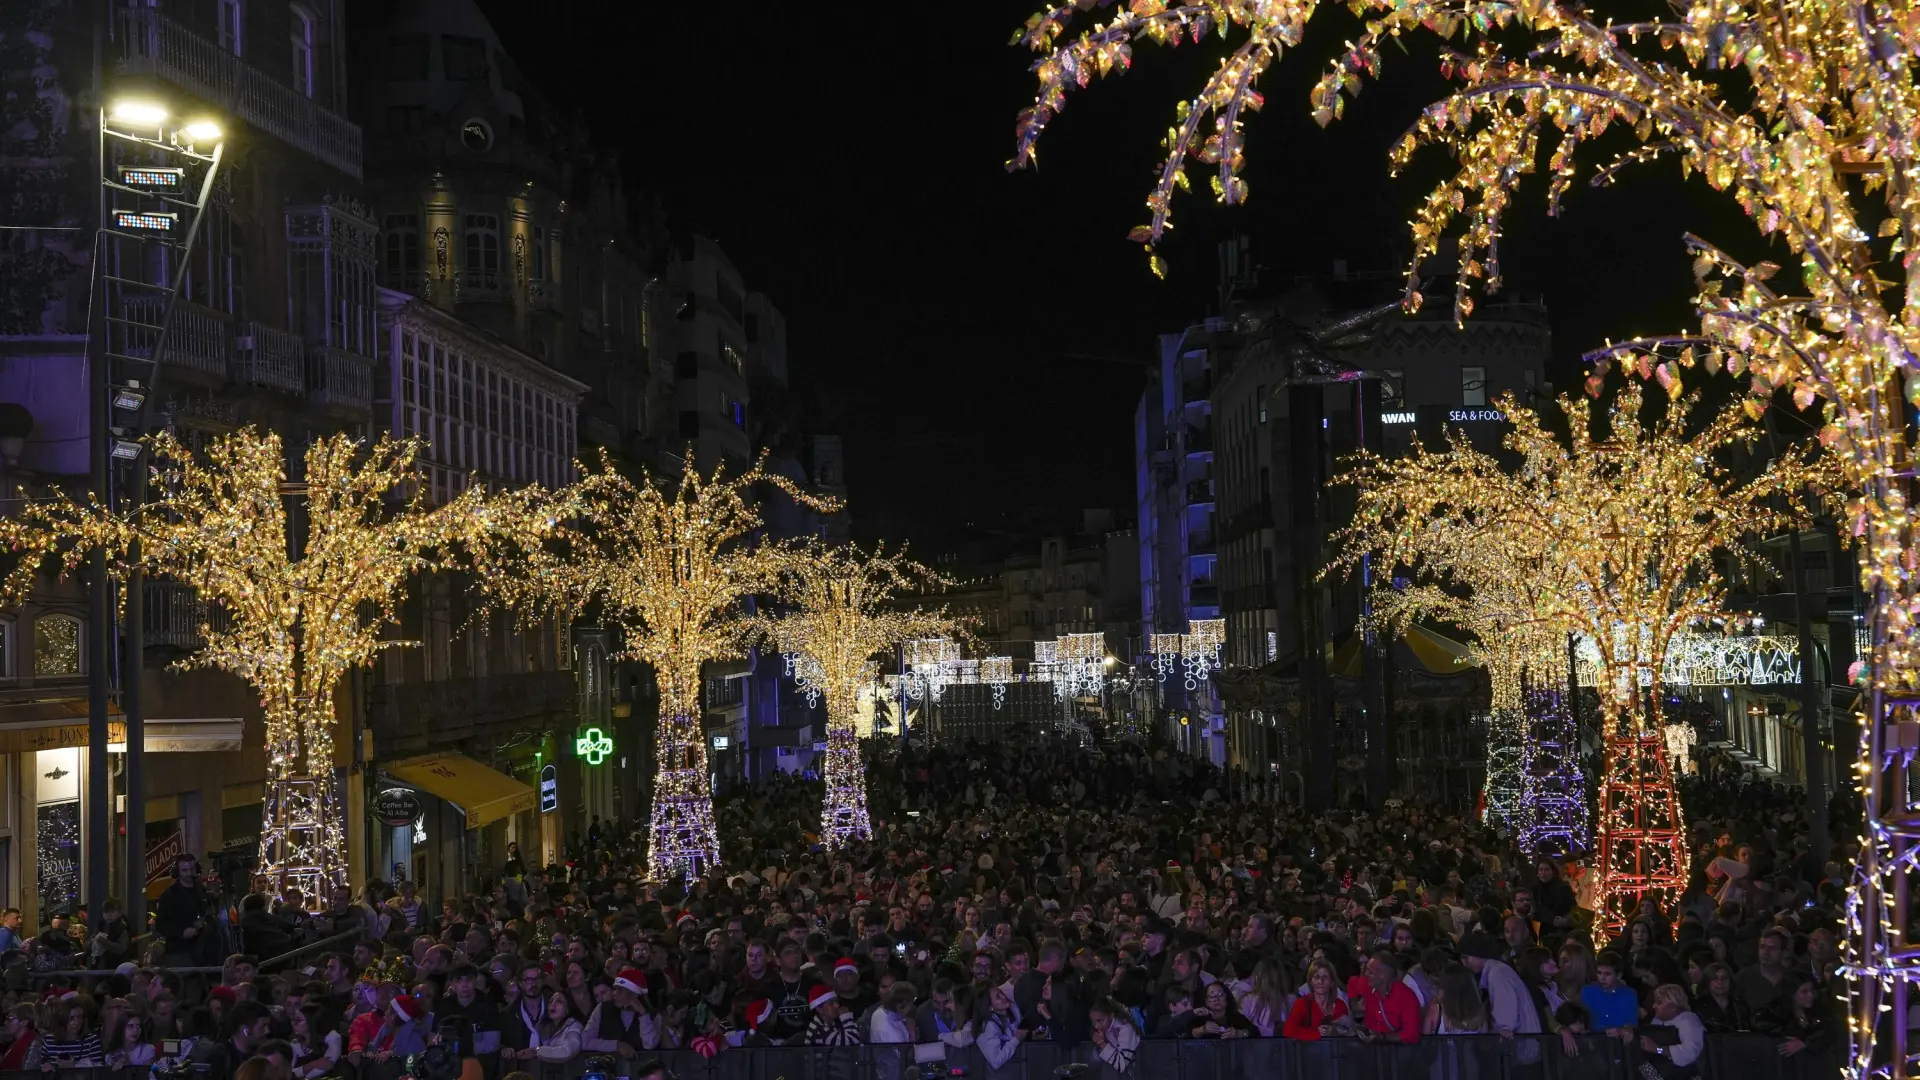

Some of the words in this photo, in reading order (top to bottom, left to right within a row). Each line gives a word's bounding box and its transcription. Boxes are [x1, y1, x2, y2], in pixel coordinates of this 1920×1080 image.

[1449, 410, 1468, 421] SEA
[1469, 410, 1477, 421] &
[381, 801, 402, 809] Coffee
[144, 841, 178, 879] UILADO
